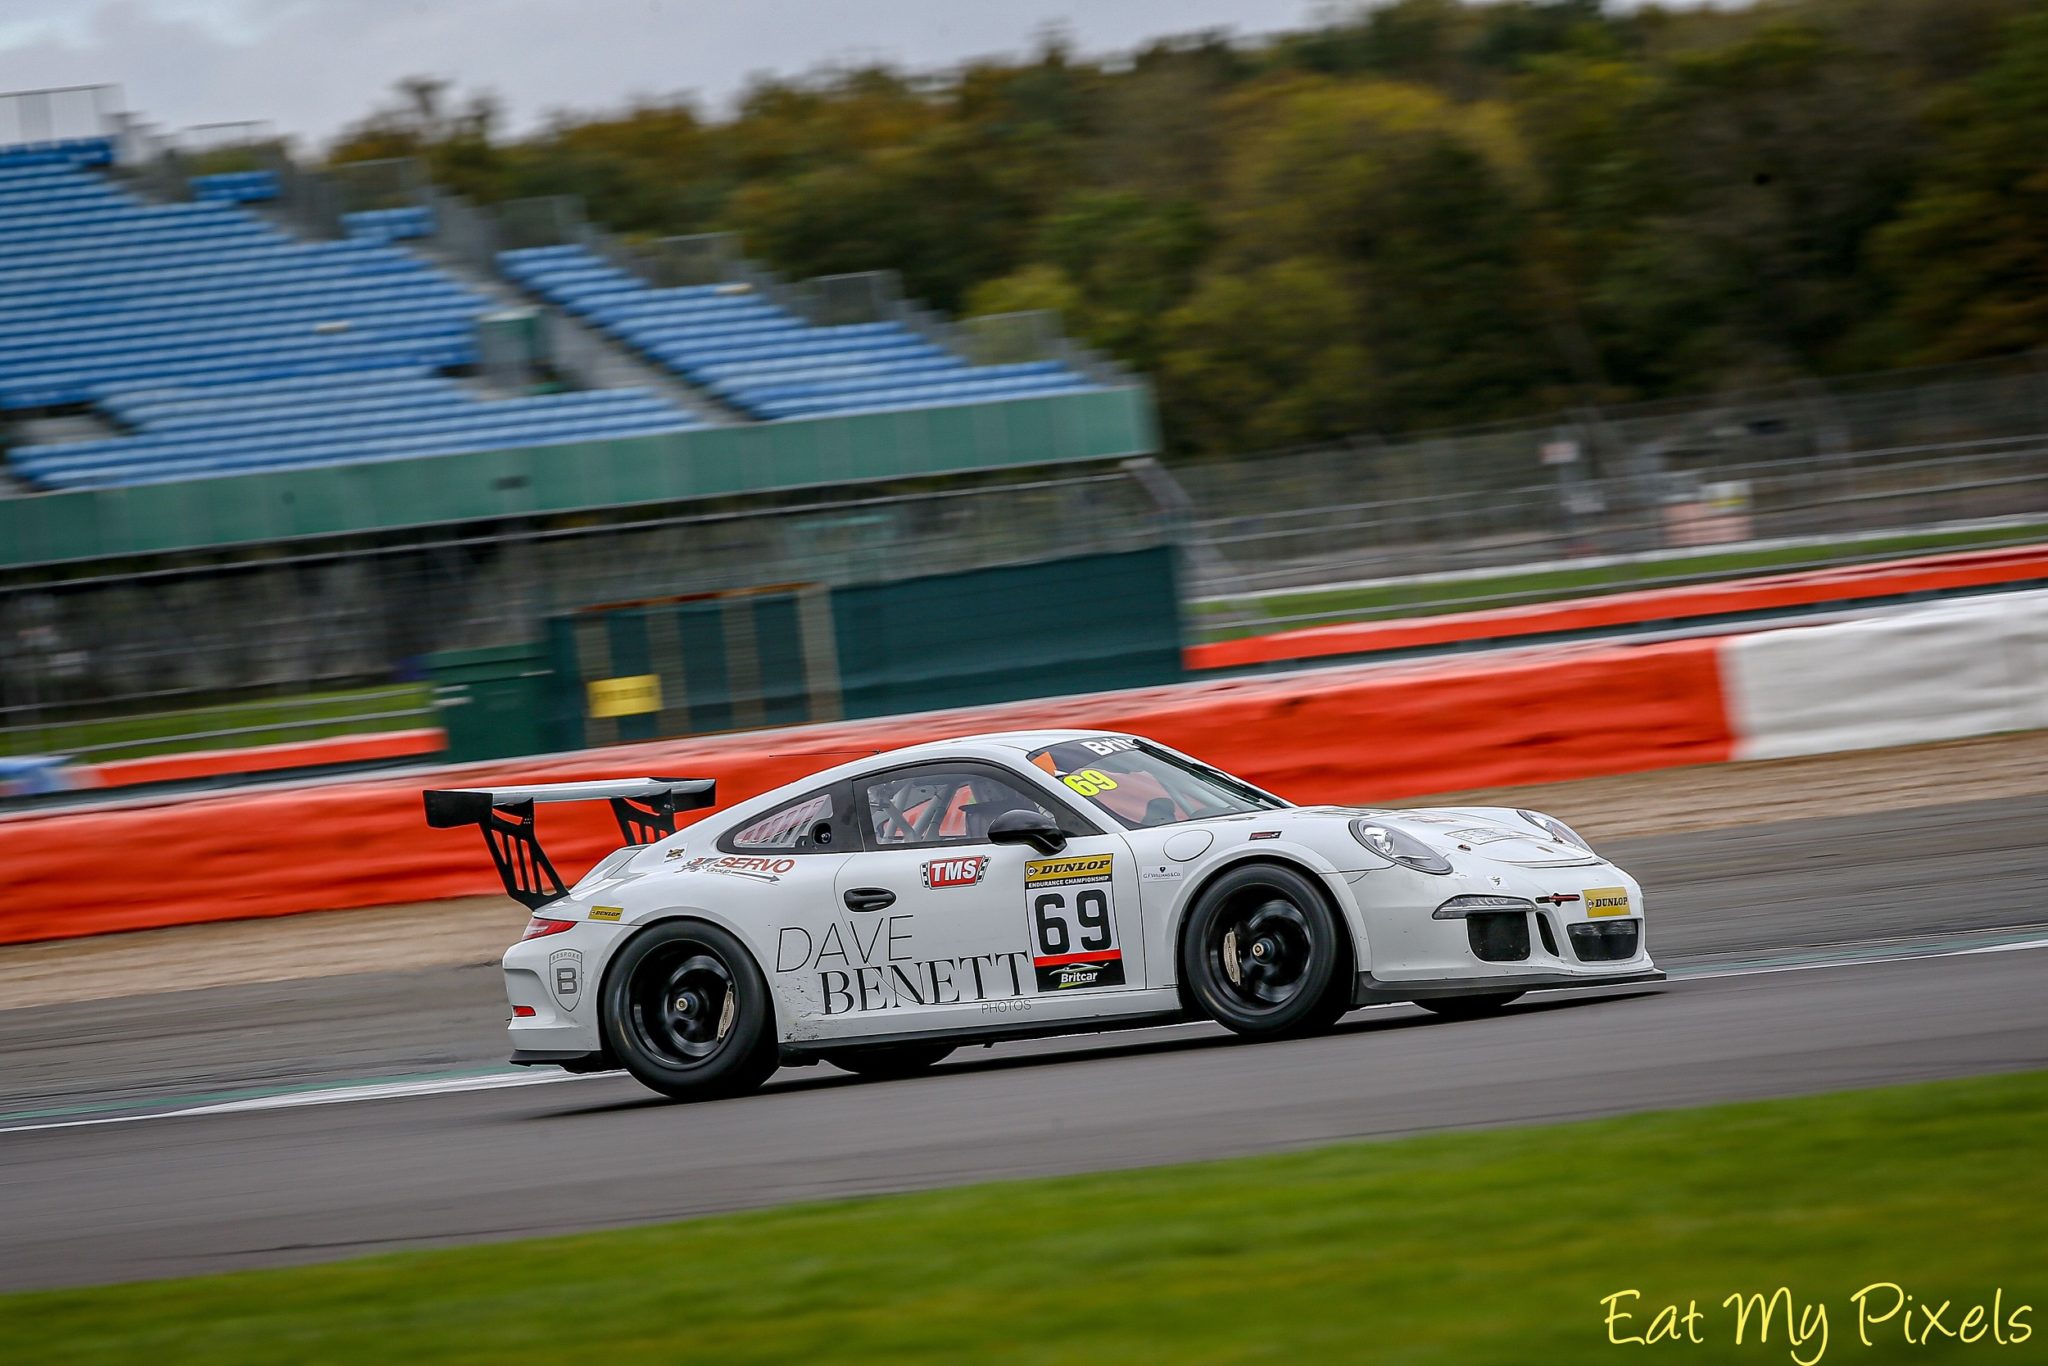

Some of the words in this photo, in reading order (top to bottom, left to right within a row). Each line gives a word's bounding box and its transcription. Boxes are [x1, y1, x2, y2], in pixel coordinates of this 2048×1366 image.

[1063, 769, 1118, 796] 69
[931, 860, 977, 882] TMS
[1040, 860, 1110, 874] DUNLOP
[1028, 879, 1064, 888] ENDURANCE
[1064, 875, 1109, 885] CHAMPIONSHIP
[1595, 896, 1628, 907] DUNLOP
[1034, 889, 1112, 955] 69
[776, 915, 913, 973] DAVE
[552, 951, 580, 960] BESPOKE
[556, 967, 578, 995] B
[817, 950, 1029, 1016] BENETT
[1061, 971, 1098, 983] Britcar
[981, 1000, 1032, 1014] PHOTOS
